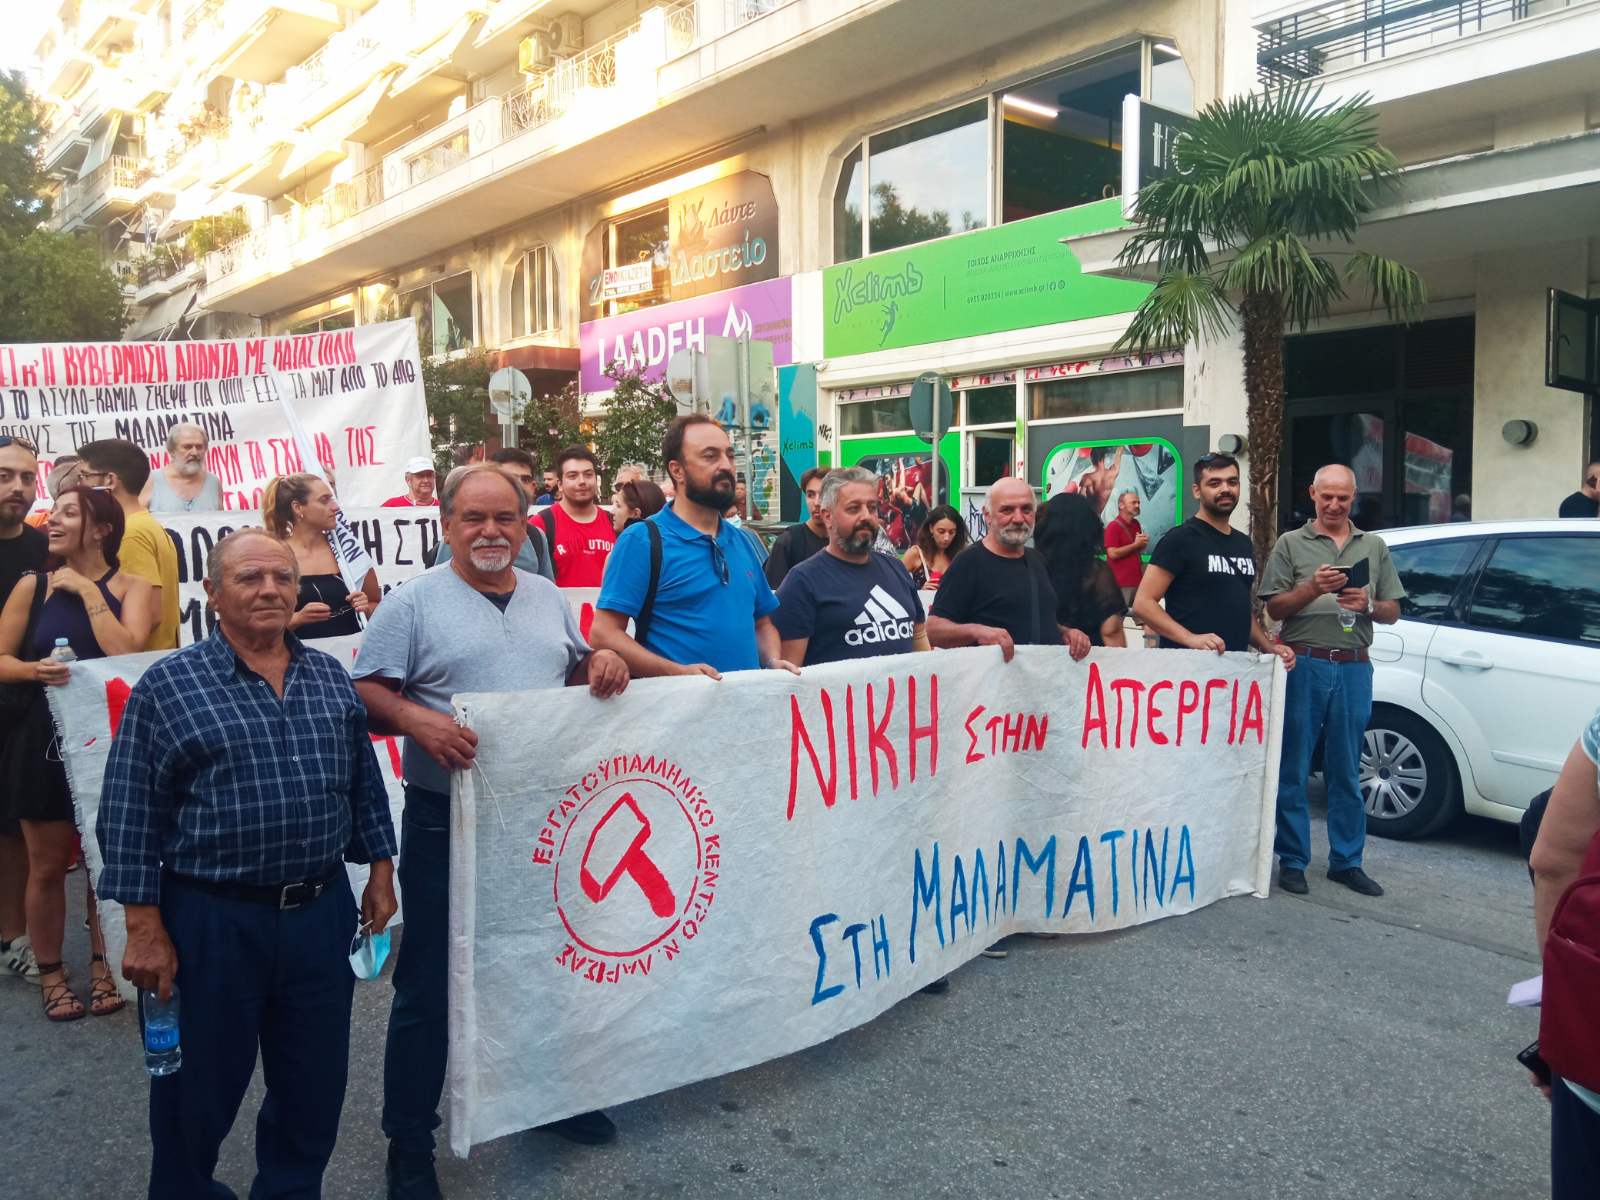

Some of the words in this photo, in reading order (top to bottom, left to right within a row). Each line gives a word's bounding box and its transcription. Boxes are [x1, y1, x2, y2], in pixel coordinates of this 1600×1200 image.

[63, 343, 169, 387] ΚΥΒΕΡΝΗΣΗ
[175, 341, 239, 382] ΑΠΑΝΤΑ
[245, 338, 270, 375] ΜΕ
[273, 331, 357, 371] ΚΑΤΑΣΤΟΛΗ
[146, 384, 188, 411] ΣΚΕΨΗ
[194, 381, 214, 407] ΓΙΑ
[288, 373, 307, 399] ΤΑ
[311, 367, 335, 398] ΜΑΤ
[341, 365, 366, 393] ΑΠΟ
[371, 362, 388, 389] ΤΟ
[115, 411, 235, 448] ΜΑΛΑΜΤΙΝΑ
[244, 441, 268, 481] ΤΑ
[344, 426, 386, 468] ΤΗΣ
[844, 619, 914, 647] adidas
[787, 673, 939, 821] ΝΙΚΗ
[964, 704, 1049, 764] ΣΤΗΝ
[1081, 661, 1265, 750] ΑΠΕΡΓΙΑ
[682, 833, 722, 940] ΚΕΝΤΡΟ
[809, 912, 890, 1007] ΣΤΗ
[910, 824, 1196, 965] ΜΑΛΑΜΑΤΙΝΑ
[555, 942, 652, 984] ΛΑΡΙΣΑΣ
